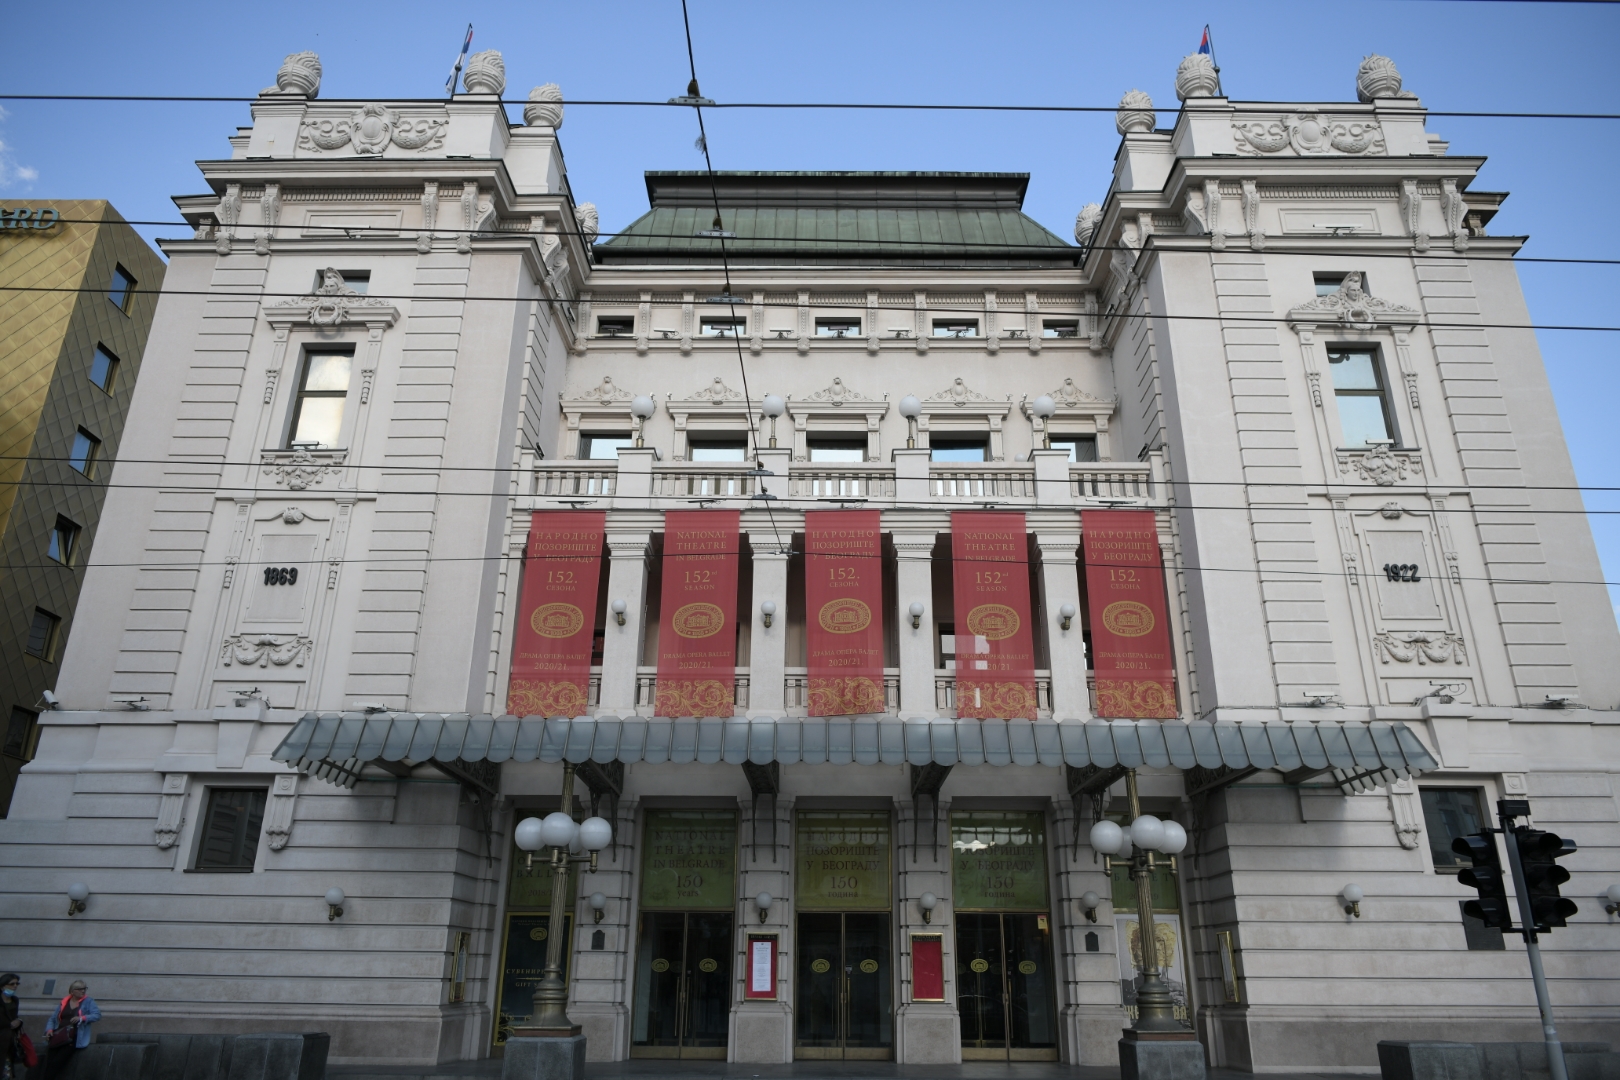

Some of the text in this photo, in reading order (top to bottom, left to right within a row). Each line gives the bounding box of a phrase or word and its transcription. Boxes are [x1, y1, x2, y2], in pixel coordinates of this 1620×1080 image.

[536, 531, 598, 541] НАРОДНО
[676, 531, 727, 540] NATIONAL
[812, 530, 875, 539] НАРОДНО
[1090, 530, 1152, 540] НАРОДНО
[534, 543, 597, 551] ПОЗОРИШТЕ
[676, 541, 727, 550] THEATRE
[812, 541, 875, 550] ПОЗОРИШТЕ
[964, 543, 1016, 551] THEATRE
[1090, 541, 1153, 551] ПОЗОРИШТЕ
[1091, 552, 1154, 562] У БЕОГРАДУ
[263, 567, 298, 586] 1869
[547, 571, 578, 584] 152.
[829, 567, 861, 580] 152.
[1110, 569, 1141, 582] 152.
[1383, 563, 1421, 583] 1922
[546, 584, 576, 592] СЕЗОНА
[534, 662, 570, 671] 2020/21.
[678, 661, 714, 670] 2020/21.
[828, 657, 864, 667] 2020/21.
[1115, 661, 1151, 670] 2020/21.
[655, 830, 726, 840] NATIONAL
[654, 845, 726, 855] THEATRE
[805, 846, 880, 856] ПОЗОРИШТЕ
[654, 859, 725, 869] IN BELGRADE
[822, 860, 880, 871] БЕОГРАДУ
[977, 860, 1035, 871] БЕОГРАДУ
[676, 875, 703, 888] 150
[830, 876, 858, 889] 150
[987, 876, 1014, 889] 150
[677, 890, 699, 899] years
